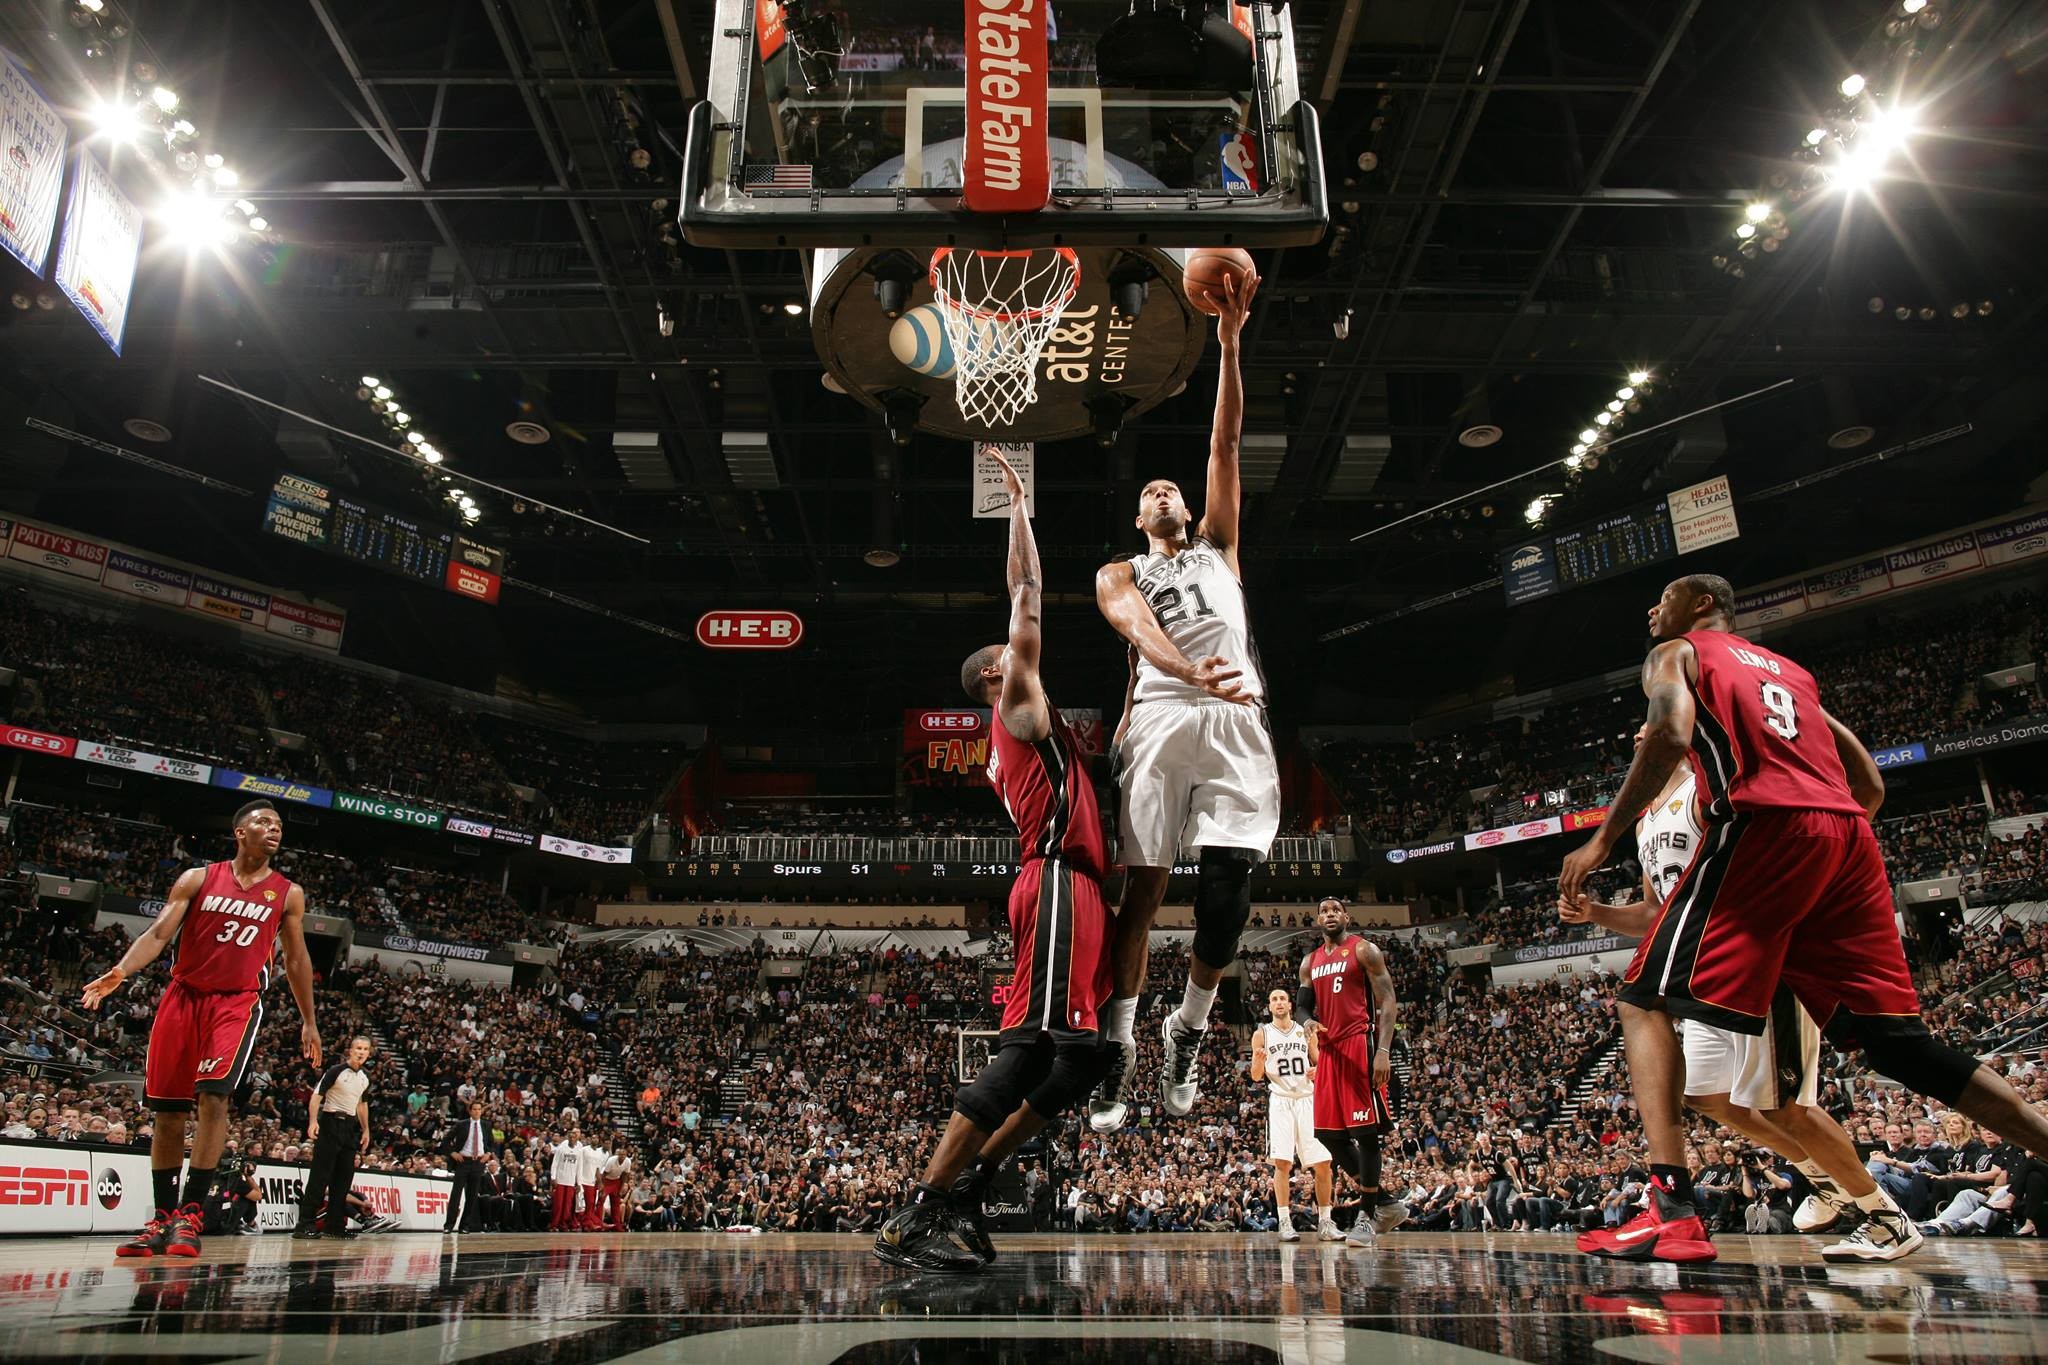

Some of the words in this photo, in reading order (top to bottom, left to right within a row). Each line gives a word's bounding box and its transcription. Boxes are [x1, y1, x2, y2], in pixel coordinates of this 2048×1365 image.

[1226, 180, 1248, 190] NBA
[1691, 481, 1727, 500] HEALTH
[1692, 490, 1728, 508] TEXAS
[295, 511, 322, 527] MOST
[338, 498, 368, 514] Spurs
[396, 518, 418, 531] Heat
[268, 511, 326, 539] POWERFUL
[274, 524, 309, 543] RADAR
[1555, 532, 1581, 545] Spurs
[1610, 515, 1632, 528] Heat
[1680, 525, 1692, 533] Be
[1680, 532, 1697, 543] San
[1698, 521, 1733, 537] Antonio
[16, 526, 73, 553] PATTY'S
[1511, 552, 1545, 571] SWBC
[1890, 536, 1974, 569] FANATIAGOS
[110, 555, 148, 575] AYRES
[150, 568, 190, 585] FORCE
[1808, 576, 1850, 593] CRAZY
[1850, 565, 1883, 584] CREW
[1151, 582, 1217, 627] 21
[1727, 646, 1781, 676] LEWIS
[1760, 680, 1800, 741] 9
[103, 747, 132, 758] WEST
[1934, 733, 1999, 754] Americus
[108, 754, 137, 765] LOOP
[168, 759, 197, 769] WEST
[172, 766, 200, 777] LOOP
[1408, 841, 1455, 859] SOUTHWEST
[773, 864, 822, 876] Spurs
[851, 864, 869, 875] 51
[971, 864, 1008, 875] 2:13
[1170, 864, 1200, 875] eat
[200, 895, 273, 922] MIAMI
[216, 920, 259, 947] 30
[782, 931, 796, 940] 113
[391, 937, 411, 947] FOX
[418, 939, 489, 961] SOUTHWEST
[1547, 936, 1619, 958] SOUTHWEST
[430, 964, 445, 973] 112
[1311, 961, 1348, 980] MIAMI
[1557, 965, 1572, 973] 117
[1332, 976, 1343, 994] 6
[1268, 1042, 1307, 1055] SPURS
[26, 1064, 38, 1078] 10
[1277, 1057, 1305, 1077] 20
[0, 1165, 90, 1206] ESPN
[97, 1176, 123, 1197] abc
[996, 1202, 1028, 1215] Finals
[260, 1211, 294, 1226] AUSTIN
